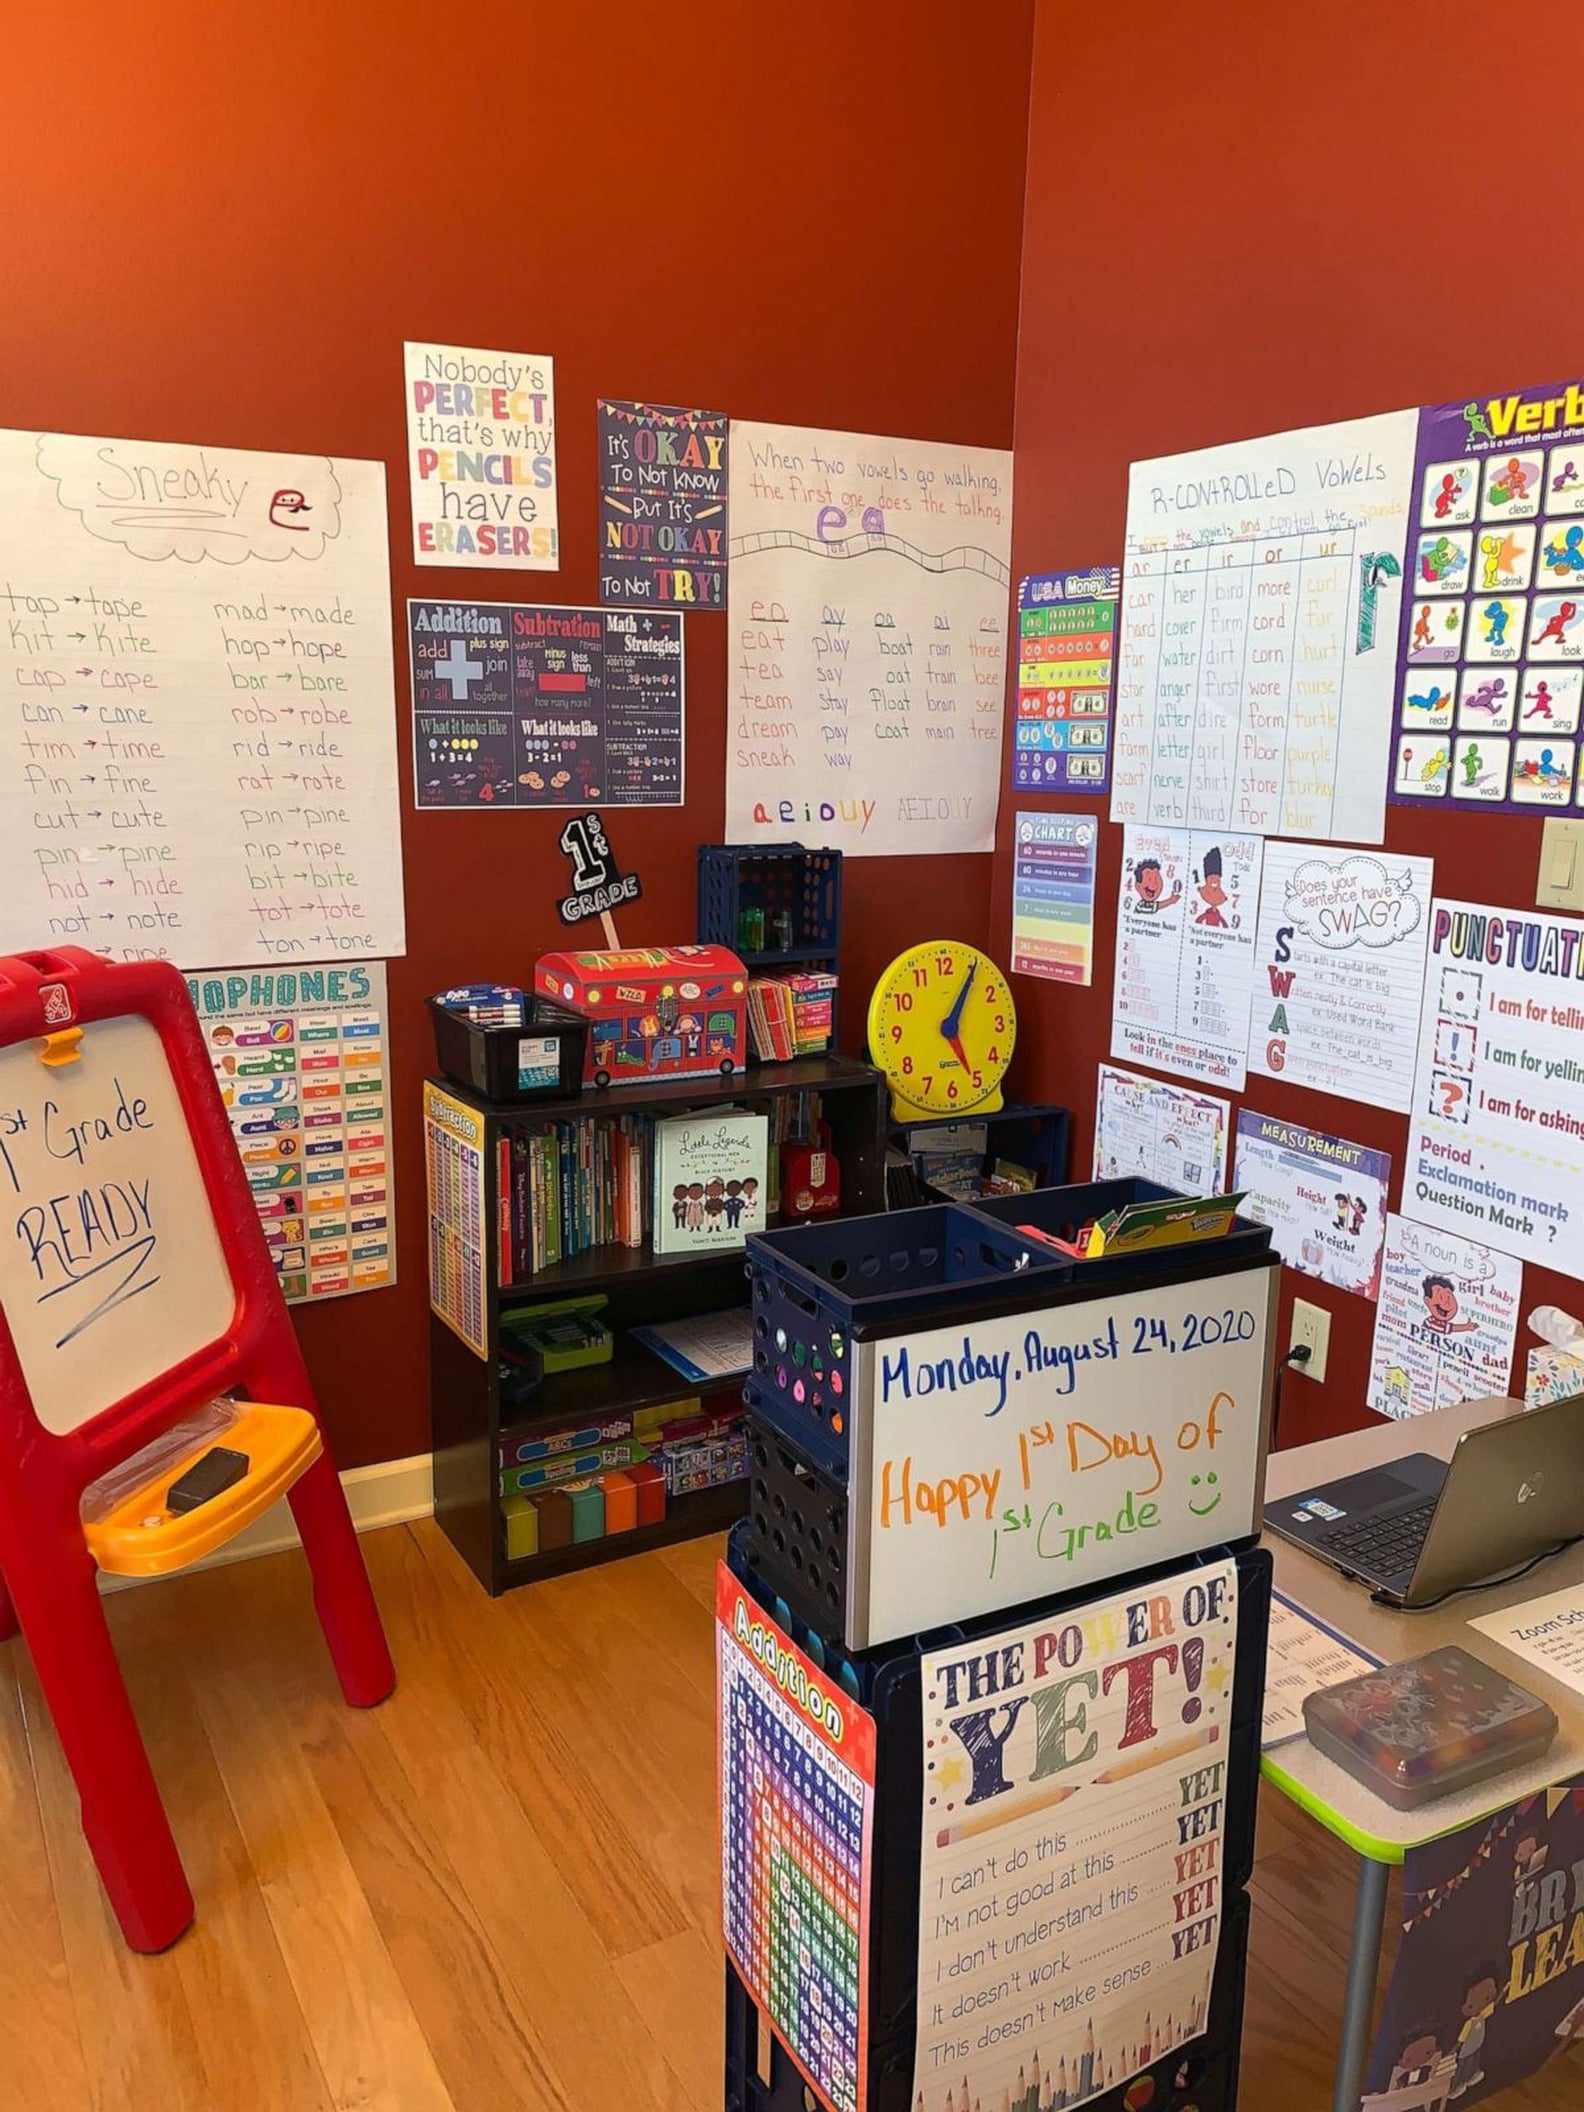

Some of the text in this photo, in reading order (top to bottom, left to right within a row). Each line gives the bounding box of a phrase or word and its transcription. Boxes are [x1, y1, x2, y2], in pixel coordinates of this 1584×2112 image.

[425, 354, 544, 392] Nobody's
[418, 417, 552, 455] that's why
[634, 429, 725, 470] OKAY
[418, 448, 552, 488] PENCILS
[748, 441, 805, 471] When
[811, 447, 845, 474] two
[857, 457, 908, 481] vowels
[917, 471, 935, 491] go
[97, 447, 248, 517] Sneaky
[750, 473, 784, 500] the
[790, 477, 832, 505] first
[842, 494, 864, 509] one
[878, 486, 912, 511] does
[922, 487, 946, 514] the
[440, 482, 537, 522] have
[1455, 510, 1470, 521] ask
[1508, 504, 1533, 515] clean
[418, 522, 557, 558] ERASERS!
[606, 521, 723, 555] NOT OKAY
[653, 569, 721, 603] TRY!
[1066, 578, 1105, 598] Money
[1258, 580, 1291, 596] more
[1502, 575, 1524, 587] drink
[0, 583, 147, 619] tap tape
[213, 594, 355, 626] mad made
[1253, 603, 1286, 630] cord
[414, 607, 502, 634] Addition
[514, 612, 600, 638] Subtration
[607, 615, 637, 633] Math
[418, 637, 448, 658] add
[470, 637, 509, 652] plus sign
[624, 634, 680, 656] Strategies
[1490, 647, 1515, 659] laugh
[1561, 645, 1581, 656] look
[486, 656, 507, 675] join
[521, 719, 598, 736] What it looks like
[738, 716, 799, 739] dream
[1553, 719, 1572, 729] sing
[233, 733, 343, 758] rid ride
[737, 744, 795, 767] sneak
[1240, 802, 1268, 824] for
[1035, 825, 1073, 841] CHART
[1223, 841, 1255, 861] Odd
[562, 876, 638, 921] GRADE
[1300, 876, 1358, 893] Does your
[1302, 887, 1392, 908] sentence have
[1319, 901, 1401, 937] SWAG?
[1433, 909, 1584, 980] PUNCTUAT
[935, 957, 953, 976] 12
[894, 992, 913, 1012] 10
[308, 1031, 330, 1039] Where
[994, 1015, 1005, 1033] 3
[988, 1047, 999, 1064] 4
[1124, 1028, 1238, 1066] Look in the ones place to
[1485, 1041, 1490, 1060] I
[1493, 1048, 1516, 1066] am
[1521, 1049, 1541, 1072] for
[1480, 1090, 1484, 1109] I
[1488, 1097, 1510, 1116] am
[1515, 1099, 1535, 1122] for
[44, 1078, 155, 1166] Grade
[678, 1126, 752, 1155] Little Legends
[1261, 1122, 1362, 1165] MEASUREMENT
[1421, 1135, 1471, 1166] Period
[1296, 1186, 1326, 1205] Height
[1418, 1158, 1568, 1222] Exclamation mark
[1416, 1182, 1484, 1219] Question
[1488, 1205, 1534, 1236] Mark
[16, 1179, 155, 1280] READY
[1314, 1229, 1356, 1252] Weight
[1411, 1235, 1486, 1274] A noun is a
[1459, 1279, 1484, 1296] girl
[1024, 1316, 1119, 1395] August
[1183, 1310, 1256, 1349] 2020
[1410, 1323, 1475, 1361] PERSON
[1482, 1353, 1508, 1370] dad
[880, 1392, 1235, 1528] Happy 1st Day of
[988, 1490, 1162, 1580] 1st Grade
[936, 1575, 1228, 1710] THE POWER OF
[1510, 1620, 1562, 1640] Zoom
[735, 1598, 843, 1741] Addition
[949, 1636, 1204, 1807] YET!
[939, 1760, 1226, 1899] I can't do this YET
[966, 1897, 1000, 1930] not
[1006, 1877, 1055, 1919] good
[1060, 1865, 1079, 1891] at
[1083, 1851, 1115, 1883] this
[1177, 1800, 1224, 1848] YET
[932, 1876, 1219, 2027] It doesn't work YET
[929, 2038, 970, 2068] This
[977, 2002, 1046, 2050] doesn't
[1103, 1962, 1152, 1990] sense
[1170, 1915, 1217, 1962] YET
